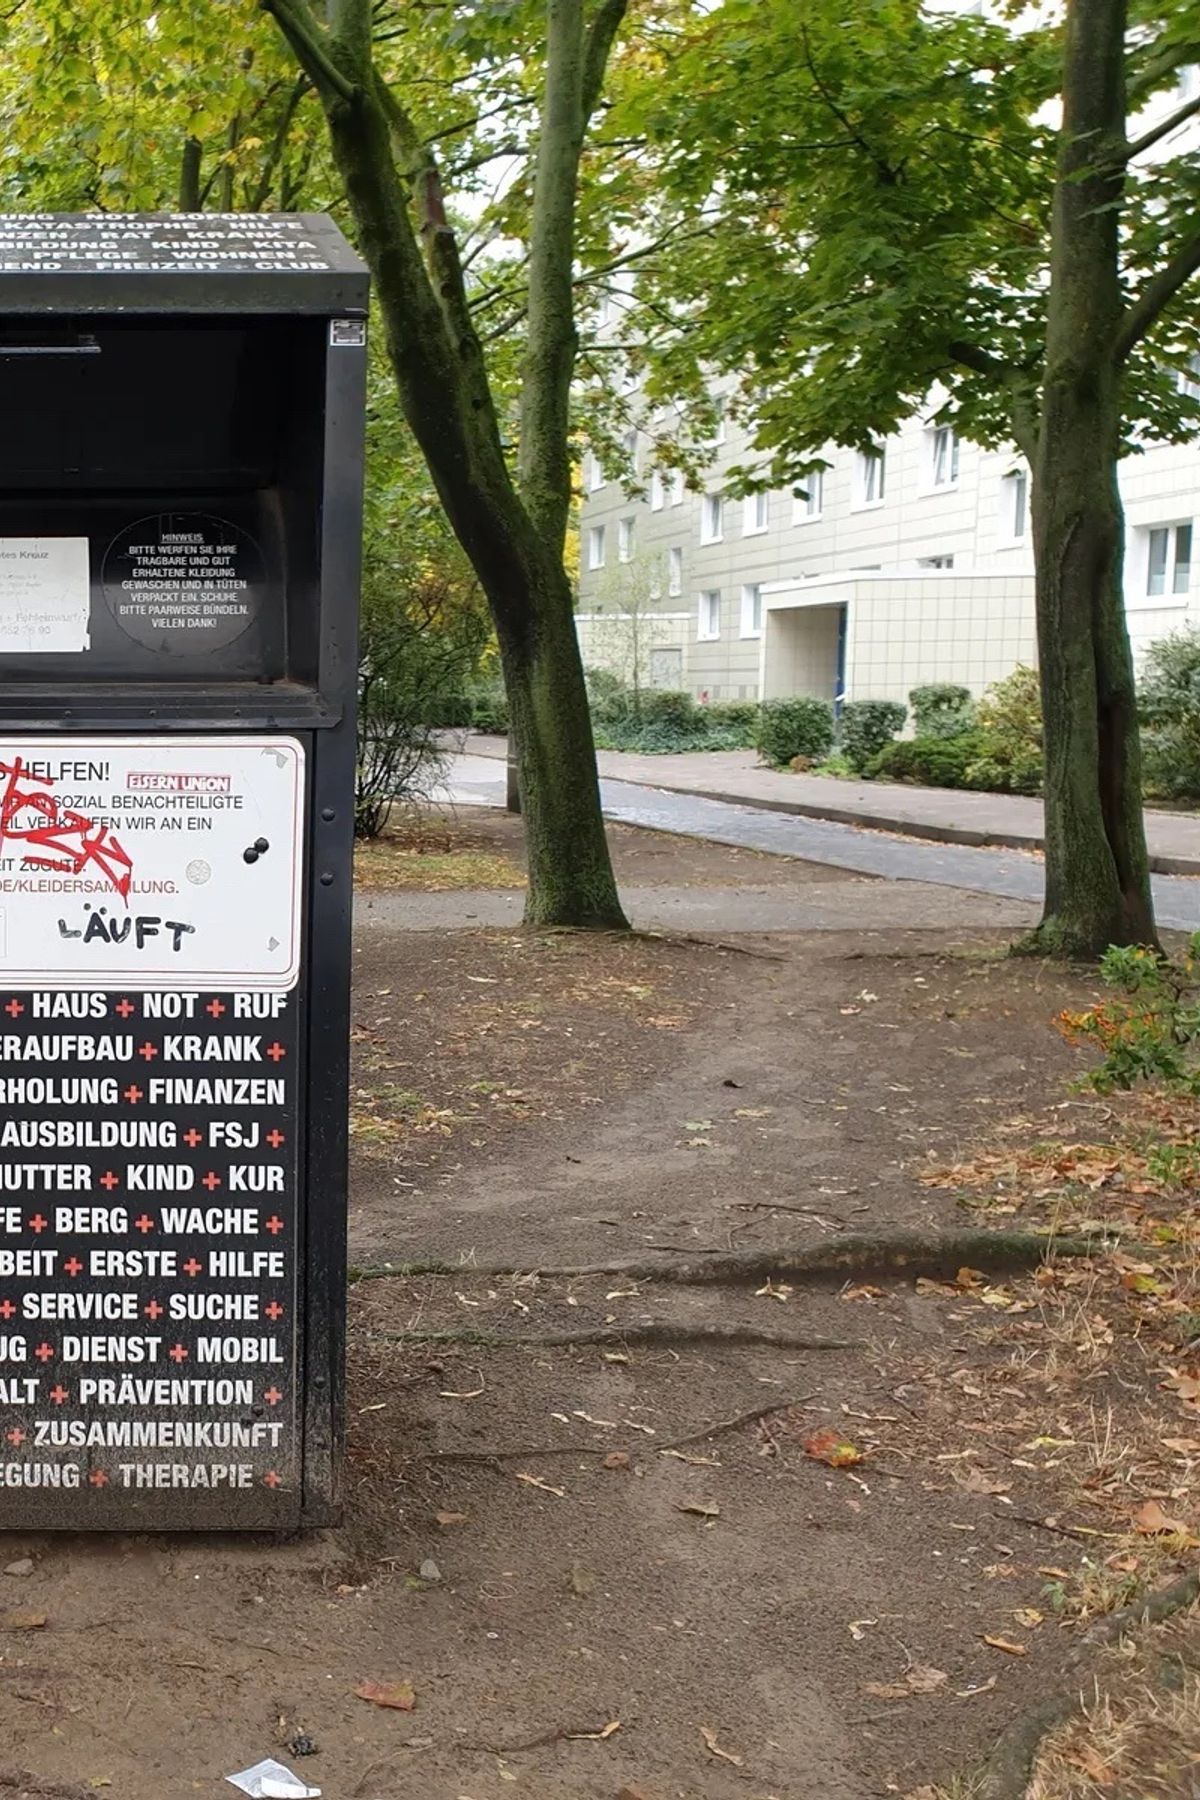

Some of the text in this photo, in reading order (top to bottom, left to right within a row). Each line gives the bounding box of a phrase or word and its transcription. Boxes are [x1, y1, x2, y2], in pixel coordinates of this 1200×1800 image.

[86, 212, 138, 221] NOT
[169, 212, 272, 221] SOFORT
[4, 221, 198, 230] KATASTROPHE
[228, 221, 304, 230] HILFE
[101, 231, 154, 240] RAT
[187, 230, 286, 239] KRANK
[151, 240, 220, 250] KIND
[252, 240, 317, 250] KITA
[33, 251, 139, 260] PFLEGE
[171, 251, 296, 260] WOHNEN
[96, 261, 221, 271] FREIZEIT
[254, 261, 330, 271] CLUB
[161, 533, 204, 543] HINWEIS
[19, 550, 49, 560] Kreuz
[129, 545, 238, 555] BITTE WERFEN SIE IHRE
[137, 556, 231, 566] TRAGBARE UND GUT
[132, 568, 236, 578] ERHALTENE KLEIDUNG
[121, 578, 247, 590] GEWASCHEN UND IN TÜTEN
[130, 592, 238, 602] VERPACKT EIN. SCHUHE
[119, 603, 249, 615] BITTE PAARWEISE BÜNDELN.
[151, 618, 217, 629] VIELEN DANK!
[54, 795, 107, 809] SOZIAL
[111, 795, 244, 810] BENACHTEILIGTE
[126, 816, 156, 830] WIR
[160, 817, 183, 830] AN
[187, 817, 212, 830] EIN
[57, 902, 197, 952] LÄUFT
[32, 992, 108, 1019] HAUS
[143, 992, 198, 1019] NOT
[234, 992, 288, 1019] RUF
[163, 1035, 263, 1062] KRANK
[149, 1078, 286, 1105] FINANZEN
[0, 1121, 177, 1148] AUSBILDUNG
[209, 1121, 260, 1148] FSJ
[127, 1163, 194, 1191] KIND
[229, 1163, 285, 1191] KUR
[55, 1207, 128, 1234] BERG
[160, 1207, 259, 1234] WACHE
[90, 1250, 177, 1278] ERSTE
[209, 1250, 284, 1278] HILFE
[22, 1293, 138, 1320] SERVICE
[169, 1293, 259, 1320] SUCHE
[62, 1336, 162, 1363] DIENST
[197, 1336, 284, 1363] MOBIL
[79, 1376, 254, 1406] PRÄVENTION
[33, 1421, 285, 1448] ZUSAMMENKUNFT
[119, 1464, 254, 1490] THERAPIE
